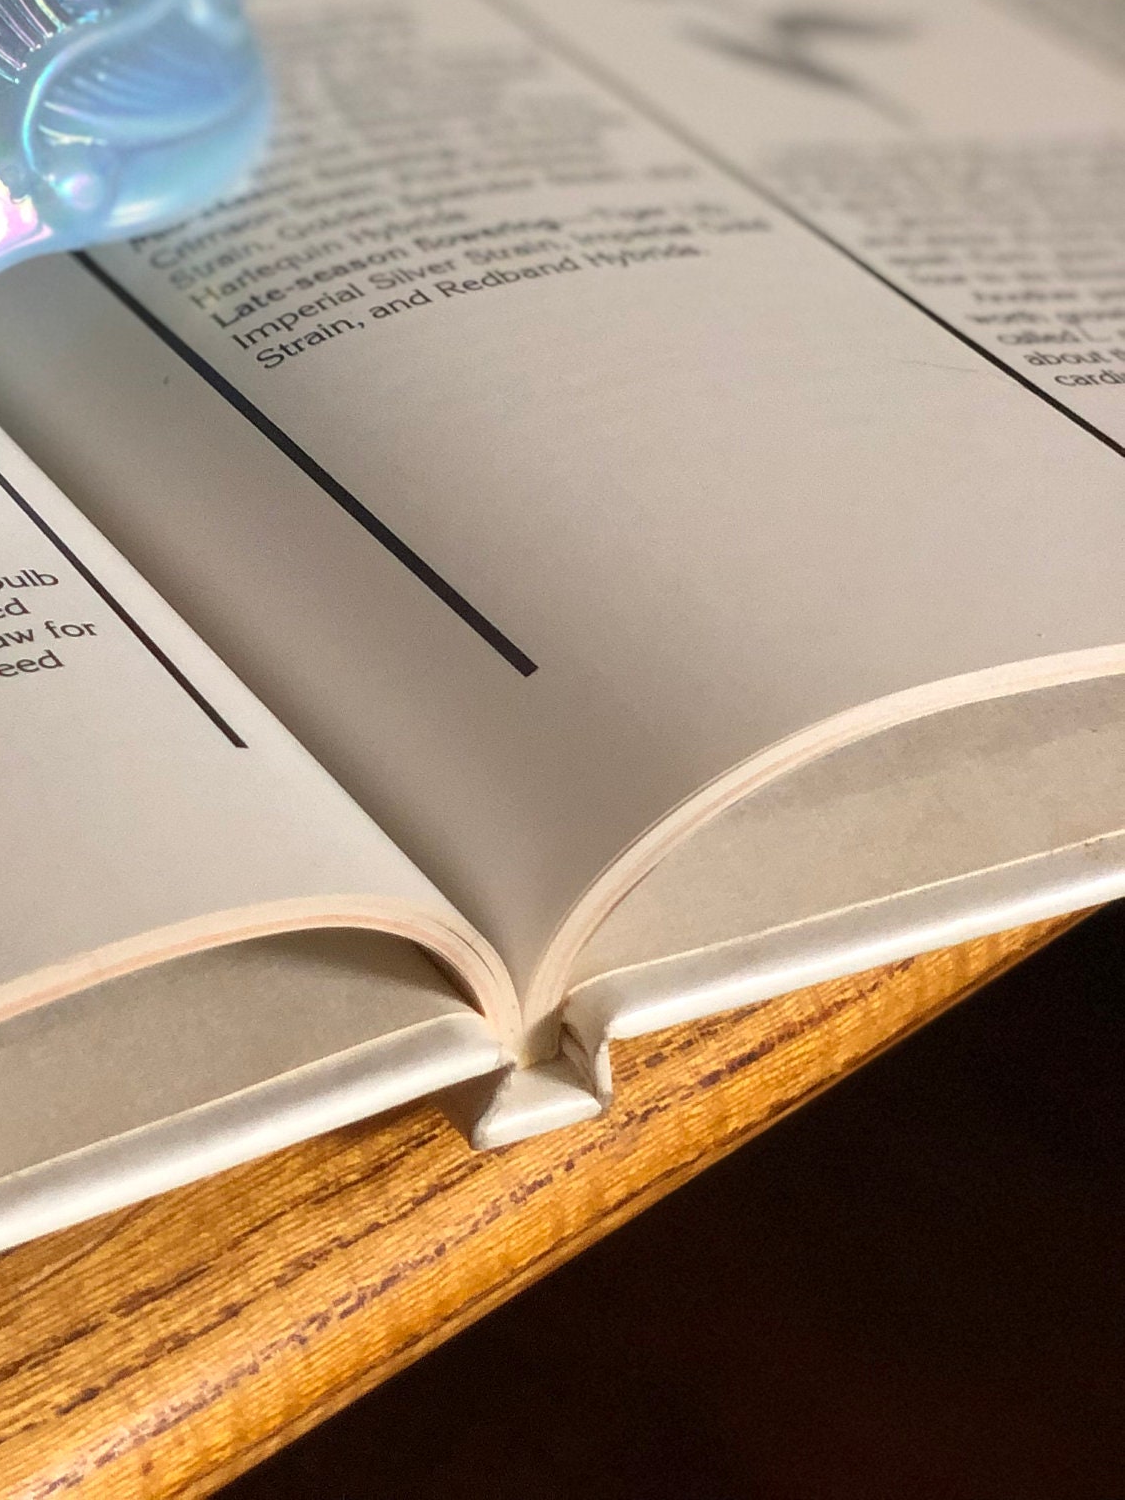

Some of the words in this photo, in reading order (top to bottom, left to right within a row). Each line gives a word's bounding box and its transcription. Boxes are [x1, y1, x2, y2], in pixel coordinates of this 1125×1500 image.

[211, 247, 408, 330] Late-season
[231, 282, 365, 350] Imperial
[368, 257, 457, 292] Silver
[256, 315, 366, 369] Strain,
[369, 289, 433, 320] and
[435, 257, 580, 299] Redband
[1023, 350, 1111, 366] about
[44, 621, 97, 639] for
